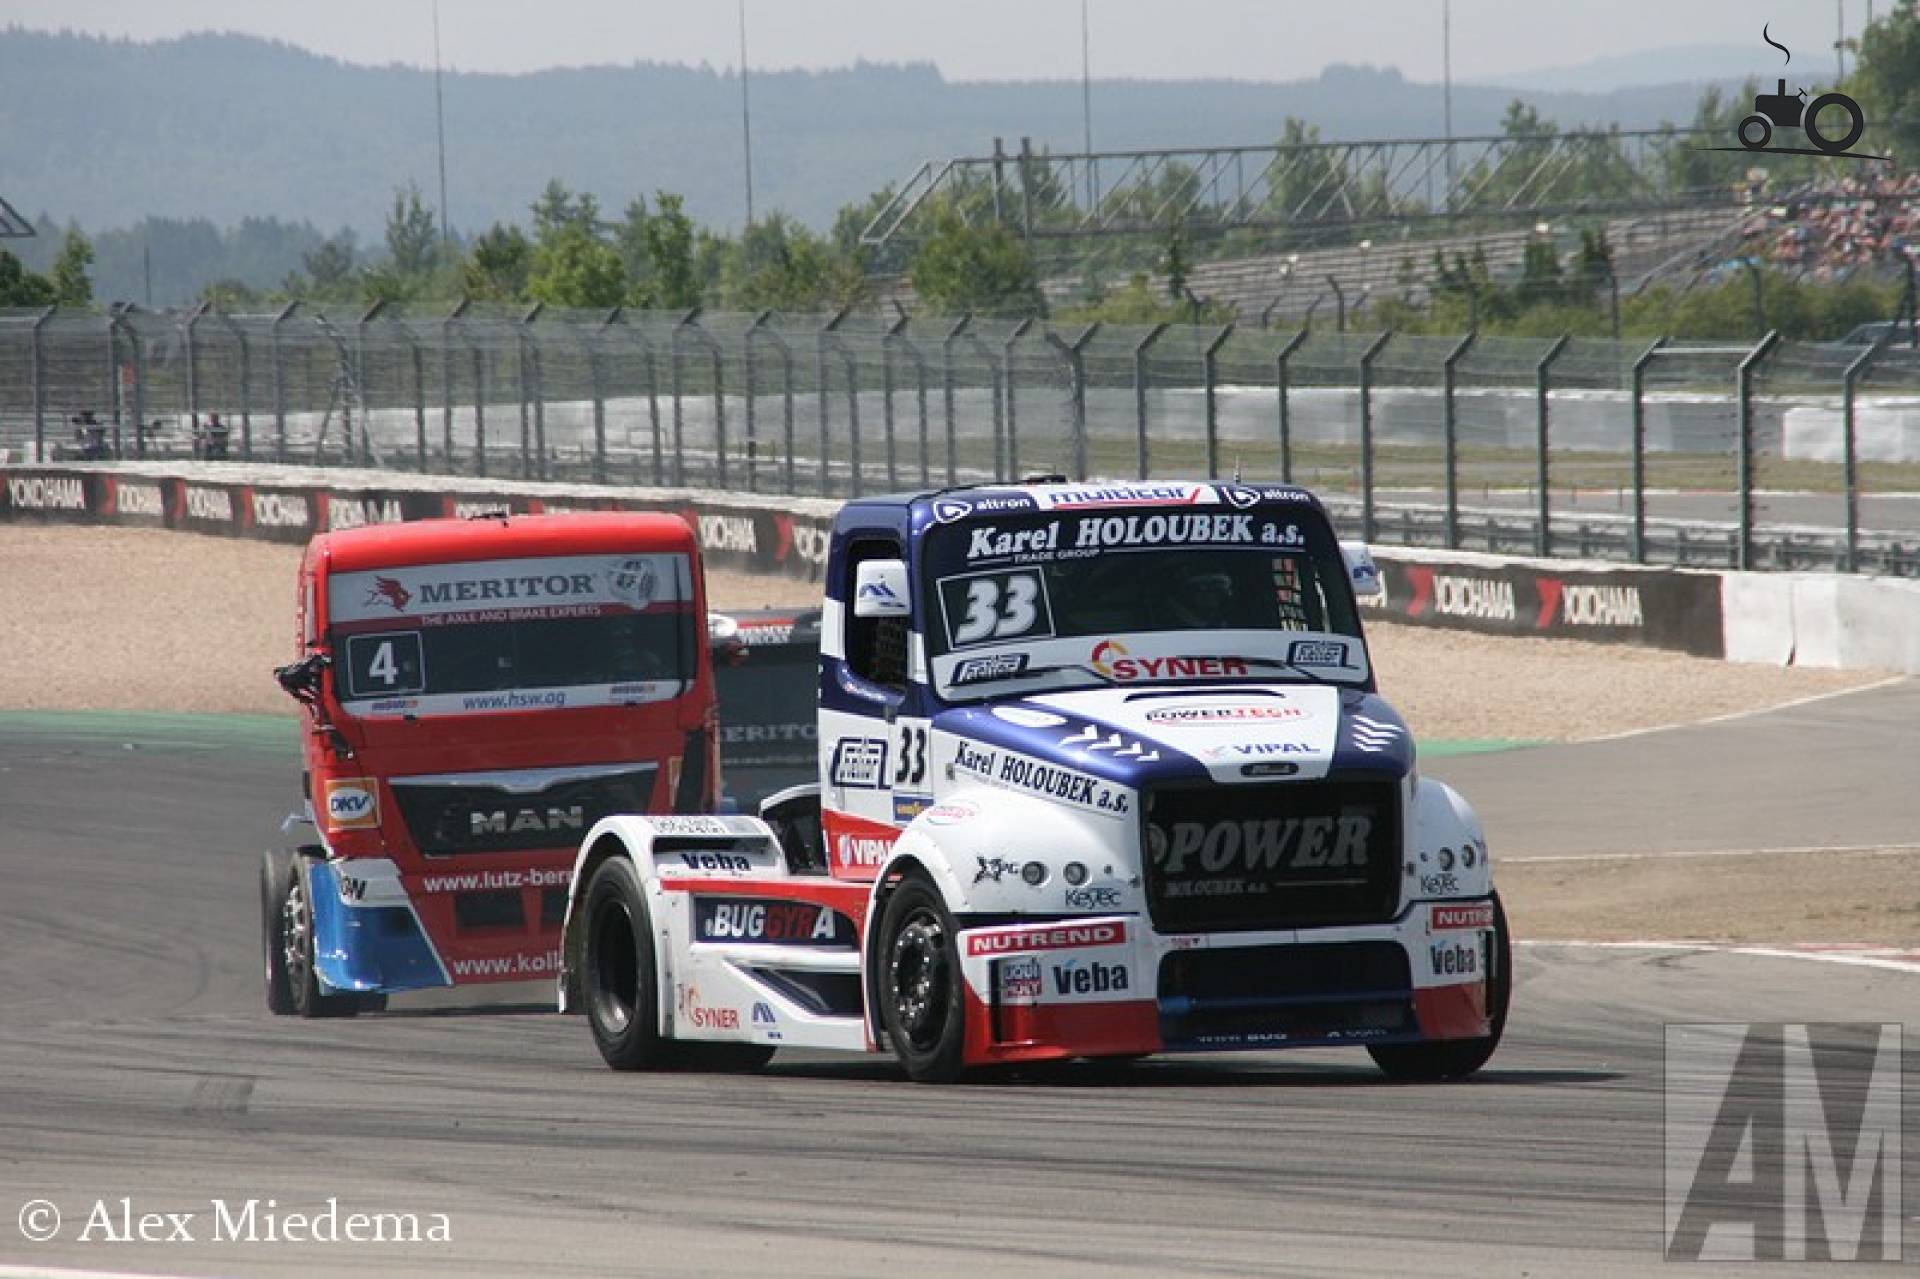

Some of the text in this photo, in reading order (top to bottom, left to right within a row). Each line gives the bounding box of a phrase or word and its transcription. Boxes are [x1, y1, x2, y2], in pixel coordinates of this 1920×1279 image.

[967, 515, 1305, 559] Karel HOLOUBEK a.s.
[420, 574, 594, 604] MERITOR
[1432, 576, 1516, 620] YOKOHAMA
[1562, 584, 1643, 626] YOKOHAMA
[422, 615, 445, 626] THE
[479, 611, 508, 622] AND
[955, 575, 1039, 643] 33
[368, 640, 398, 684] 4
[1112, 656, 1249, 680] SYNER
[726, 723, 818, 743] ERITO
[1232, 743, 1321, 755] VIPAL
[896, 725, 927, 783] 33
[954, 740, 997, 776] Karel
[1000, 754, 1098, 804] HOLOUBEK
[331, 794, 369, 812] DKV
[471, 805, 583, 835] MAN
[1164, 816, 1374, 873] POWER
[974, 927, 1115, 952] NUTREND
